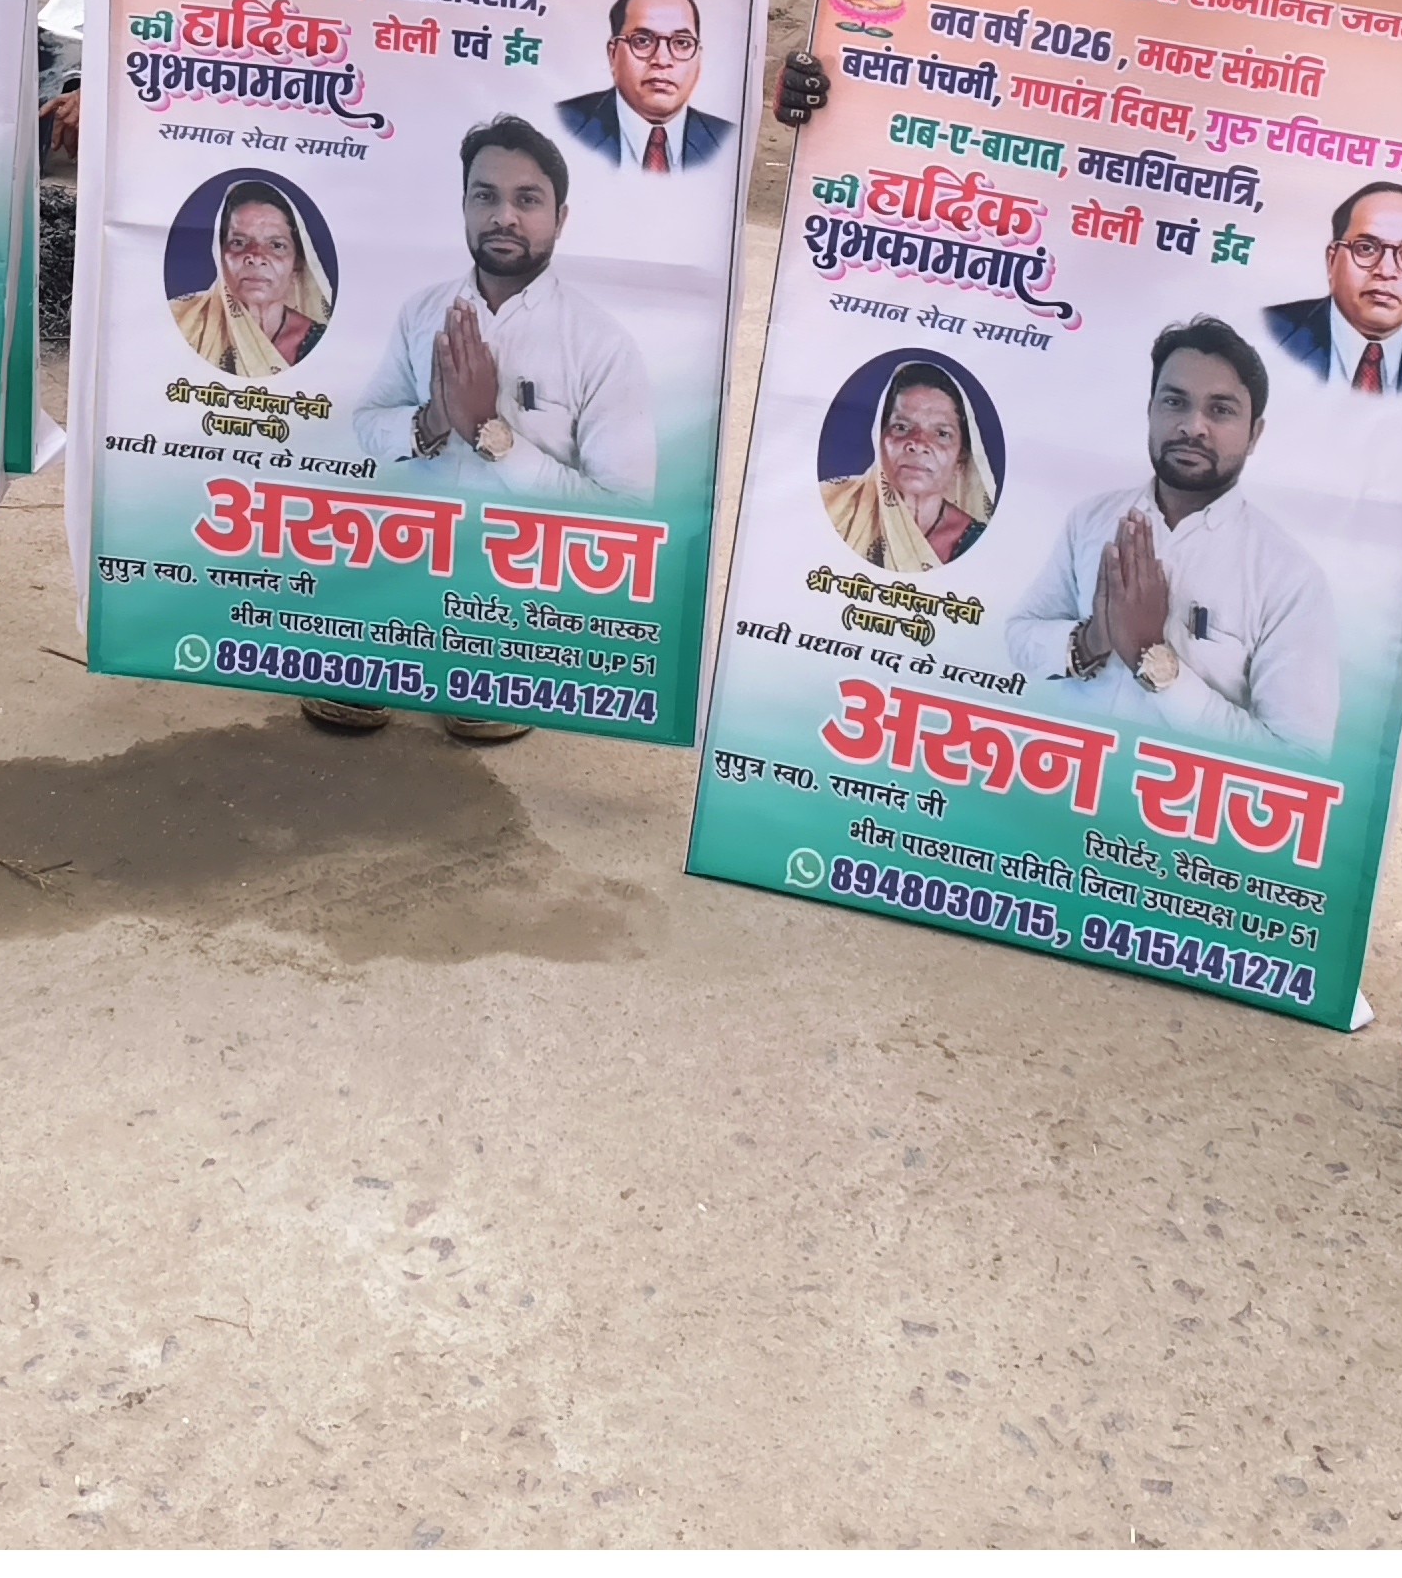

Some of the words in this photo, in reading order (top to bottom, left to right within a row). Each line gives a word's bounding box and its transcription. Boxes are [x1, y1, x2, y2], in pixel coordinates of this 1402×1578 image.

[930, 3, 979, 39] नव
[983, 8, 1030, 48] वर्ष
[1137, 38, 1218, 80] मकर
[1221, 47, 1326, 98] संक्रांति
[158, 123, 235, 146] सम्मान
[241, 125, 289, 152] सेवा
[296, 136, 370, 161] समर्पण
[291, 390, 333, 421] देवी
[485, 510, 666, 599] राज
[217, 640, 435, 699] 8948030715,
[449, 670, 655, 721] 9415441274
[714, 749, 766, 782] सुपुत्र
[829, 775, 910, 810] रामानंद
[917, 789, 947, 818] जी
[1137, 744, 1340, 863] राज
[850, 817, 895, 849] भीम
[902, 833, 995, 872] पाठशाला
[1001, 853, 1073, 890] समिति
[1080, 866, 1137, 904] जिला
[1143, 889, 1233, 928] उपाध्यक्ष
[1291, 925, 1316, 948] 51
[831, 858, 1068, 946] 8948030715,
[1084, 917, 1312, 1001] 9415441274
